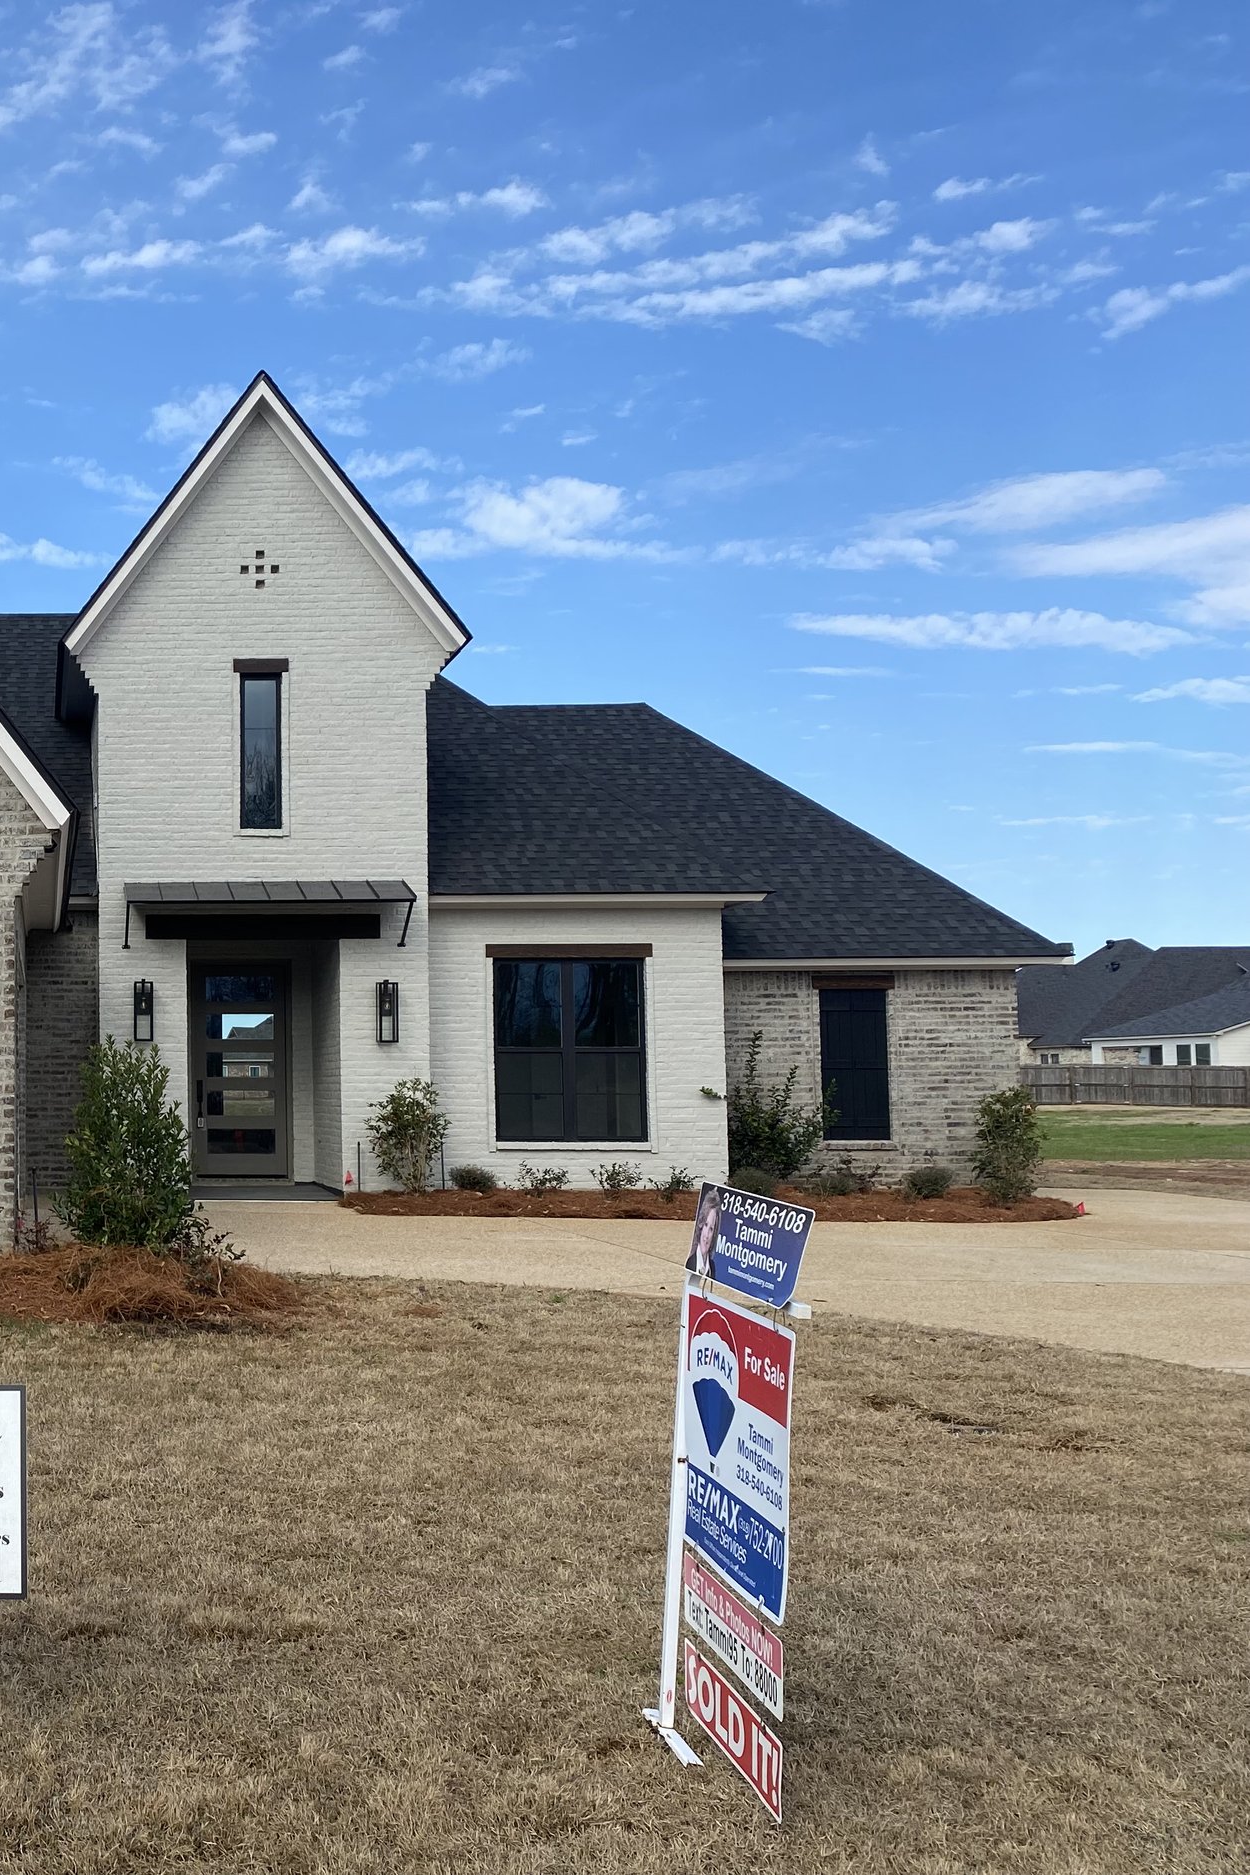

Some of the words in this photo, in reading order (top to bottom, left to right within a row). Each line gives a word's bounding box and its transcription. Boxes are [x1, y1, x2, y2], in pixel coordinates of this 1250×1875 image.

[721, 1192, 806, 1234] 318-540-6108
[735, 1218, 774, 1250] Tammi
[715, 1233, 788, 1282] Montgomery
[696, 1347, 734, 1386] RE/MAX
[744, 1346, 762, 1376] For
[763, 1357, 786, 1391] Sale
[737, 1436, 785, 1489] Montgomery
[748, 1422, 774, 1456] Tammi
[736, 1464, 783, 1511] 318-540-6108
[687, 1498, 702, 1525] Real
[701, 1509, 720, 1541] Estate
[719, 1525, 748, 1565] Services
[688, 1468, 740, 1535] RE/MAX
[748, 1516, 784, 1570] 752-2700
[690, 1567, 705, 1599] GET
[705, 1583, 718, 1612] Info
[718, 1594, 725, 1618] &
[725, 1600, 750, 1644] Photos
[751, 1625, 773, 1668] NOW!
[704, 1607, 738, 1666] Tammi95
[740, 1643, 753, 1682] To:
[754, 1658, 778, 1708] 88000
[687, 1654, 746, 1758] SOLD
[751, 1721, 779, 1807] IT!
